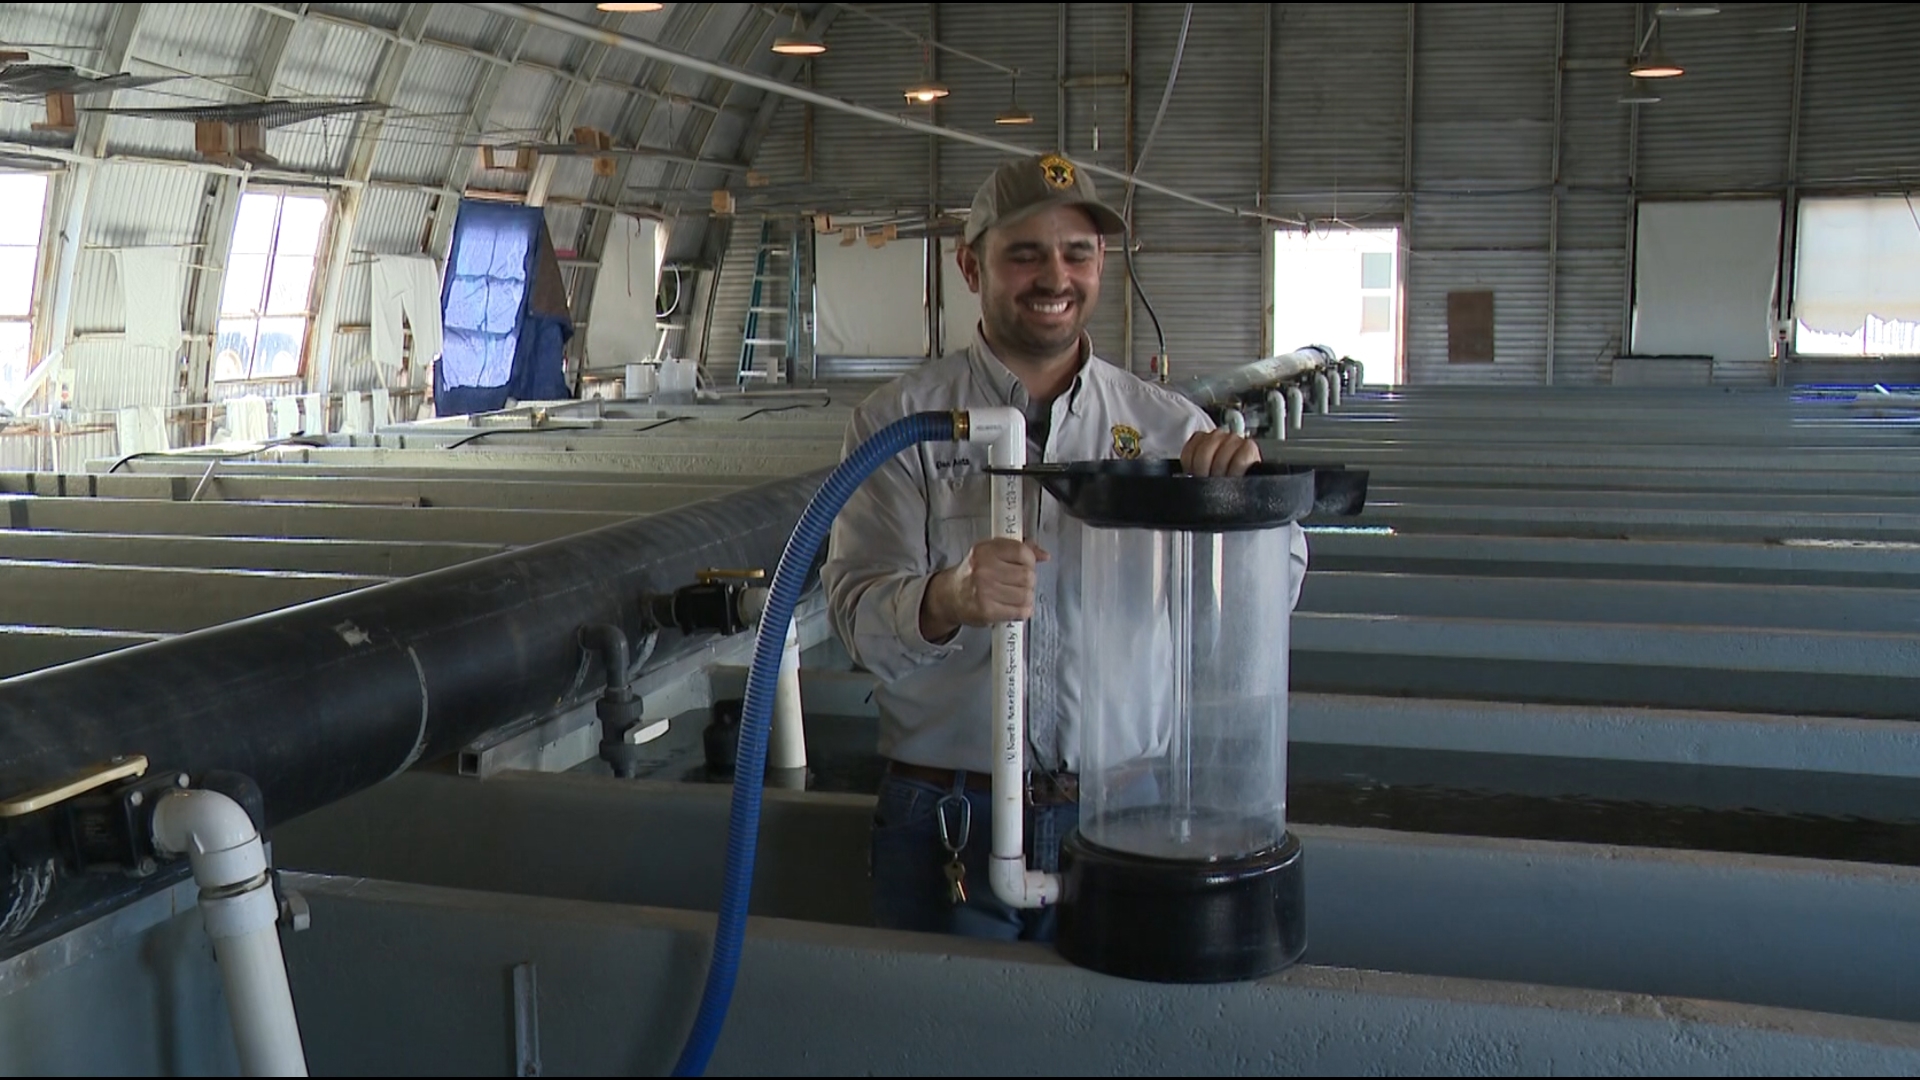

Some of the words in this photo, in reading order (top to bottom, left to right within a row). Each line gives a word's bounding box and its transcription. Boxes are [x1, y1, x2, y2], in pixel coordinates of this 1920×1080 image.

[1004, 514, 1017, 535] PVC
[1005, 631, 1018, 675] Specialty
[1007, 674, 1017, 721] American
[1006, 723, 1017, 751] North
